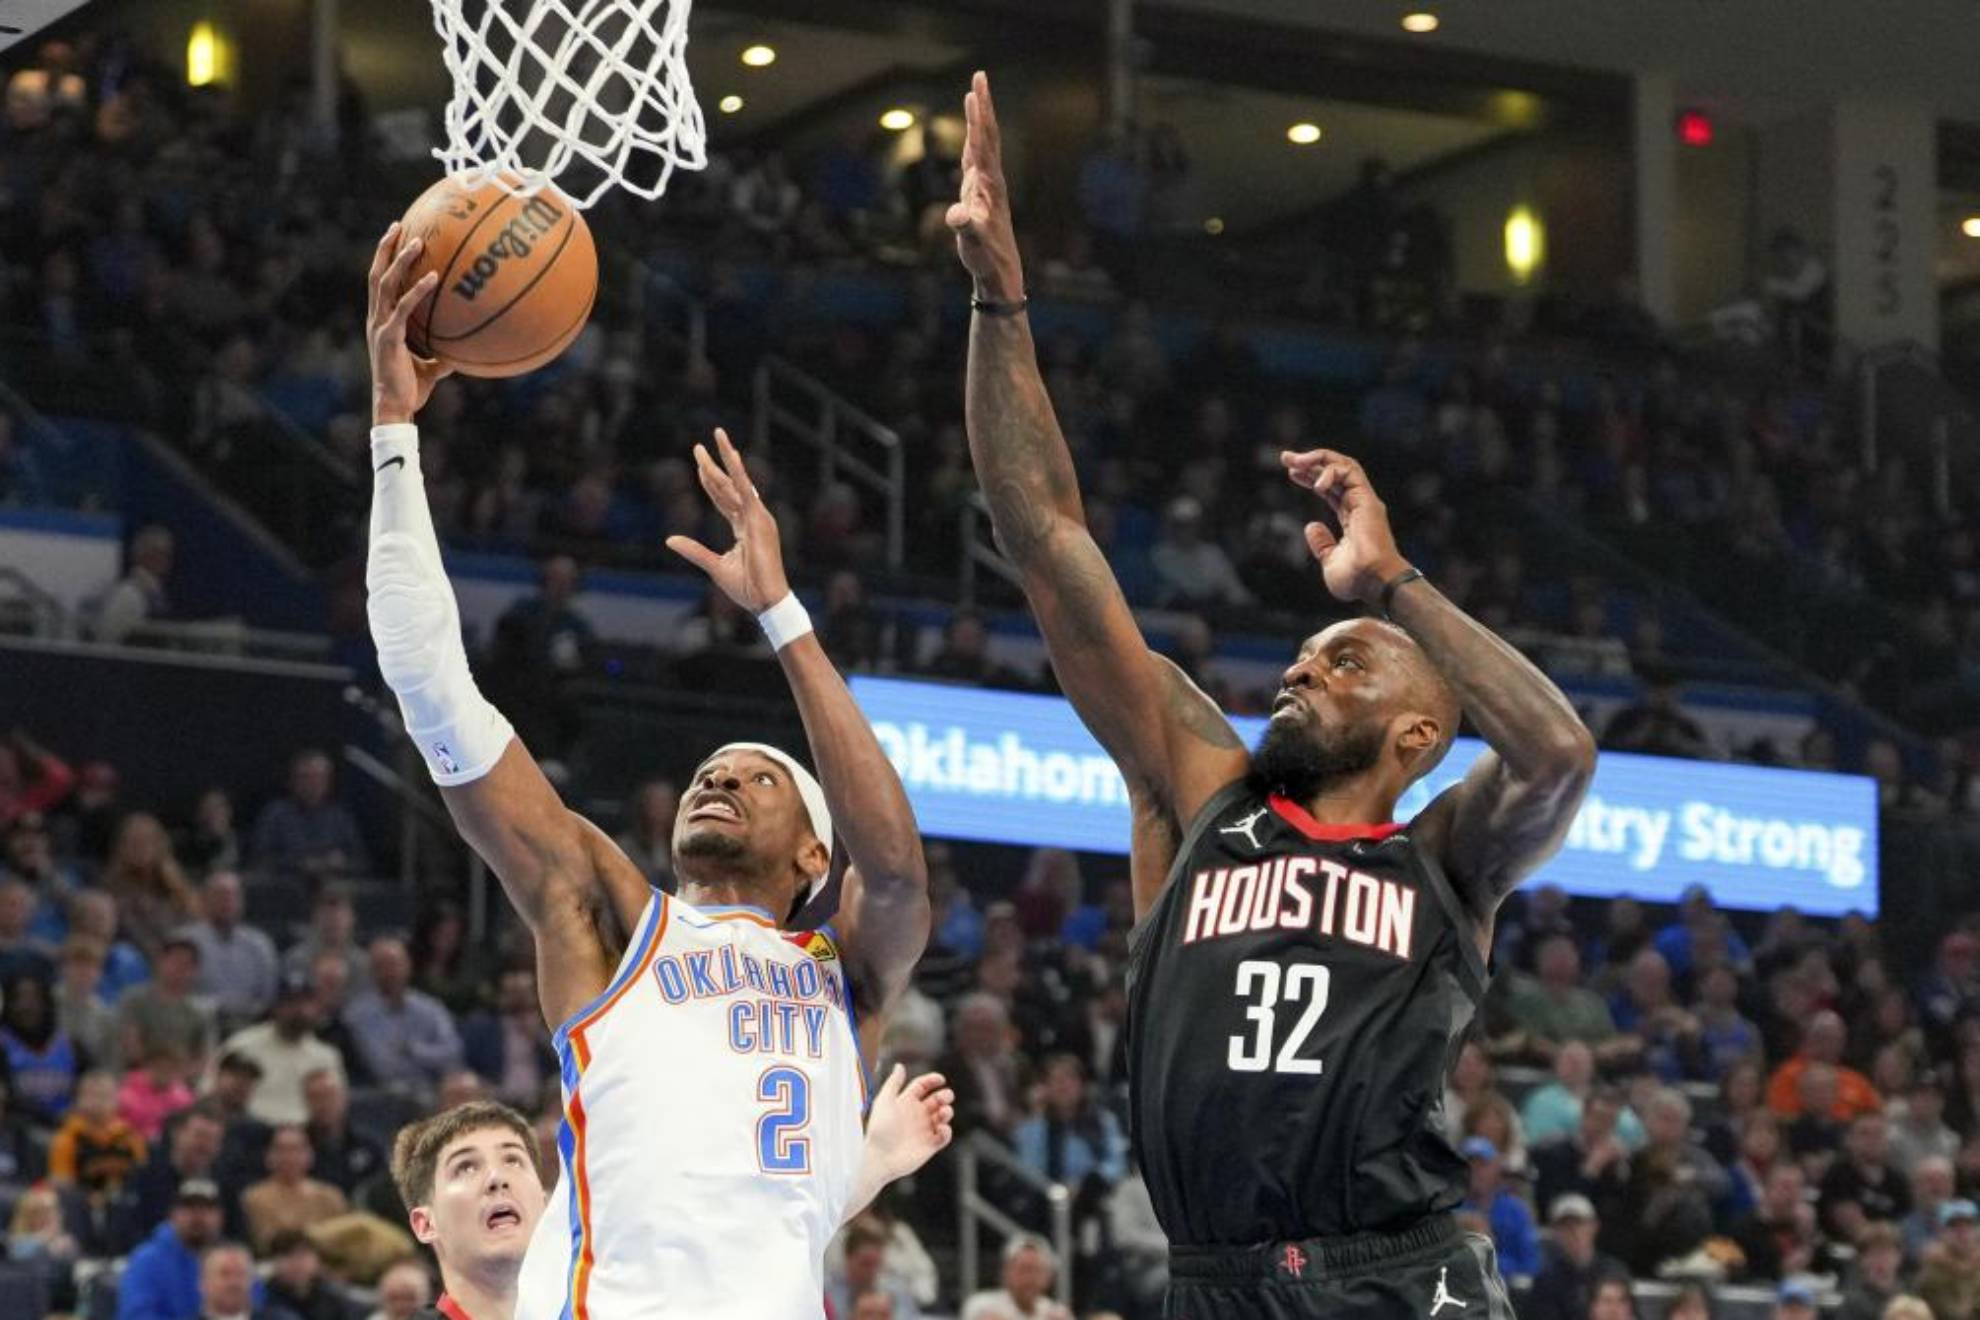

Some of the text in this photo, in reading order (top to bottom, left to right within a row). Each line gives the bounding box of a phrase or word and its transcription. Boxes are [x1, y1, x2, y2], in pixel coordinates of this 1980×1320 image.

[453, 196, 562, 299] Wilson
[1873, 164, 1901, 317] 225
[1682, 802, 1864, 888] Strong
[1183, 855, 1417, 962] HOUSTON
[728, 999, 828, 1058] CITY
[1227, 960, 1330, 1074] 32
[756, 1065, 810, 1174] 2
